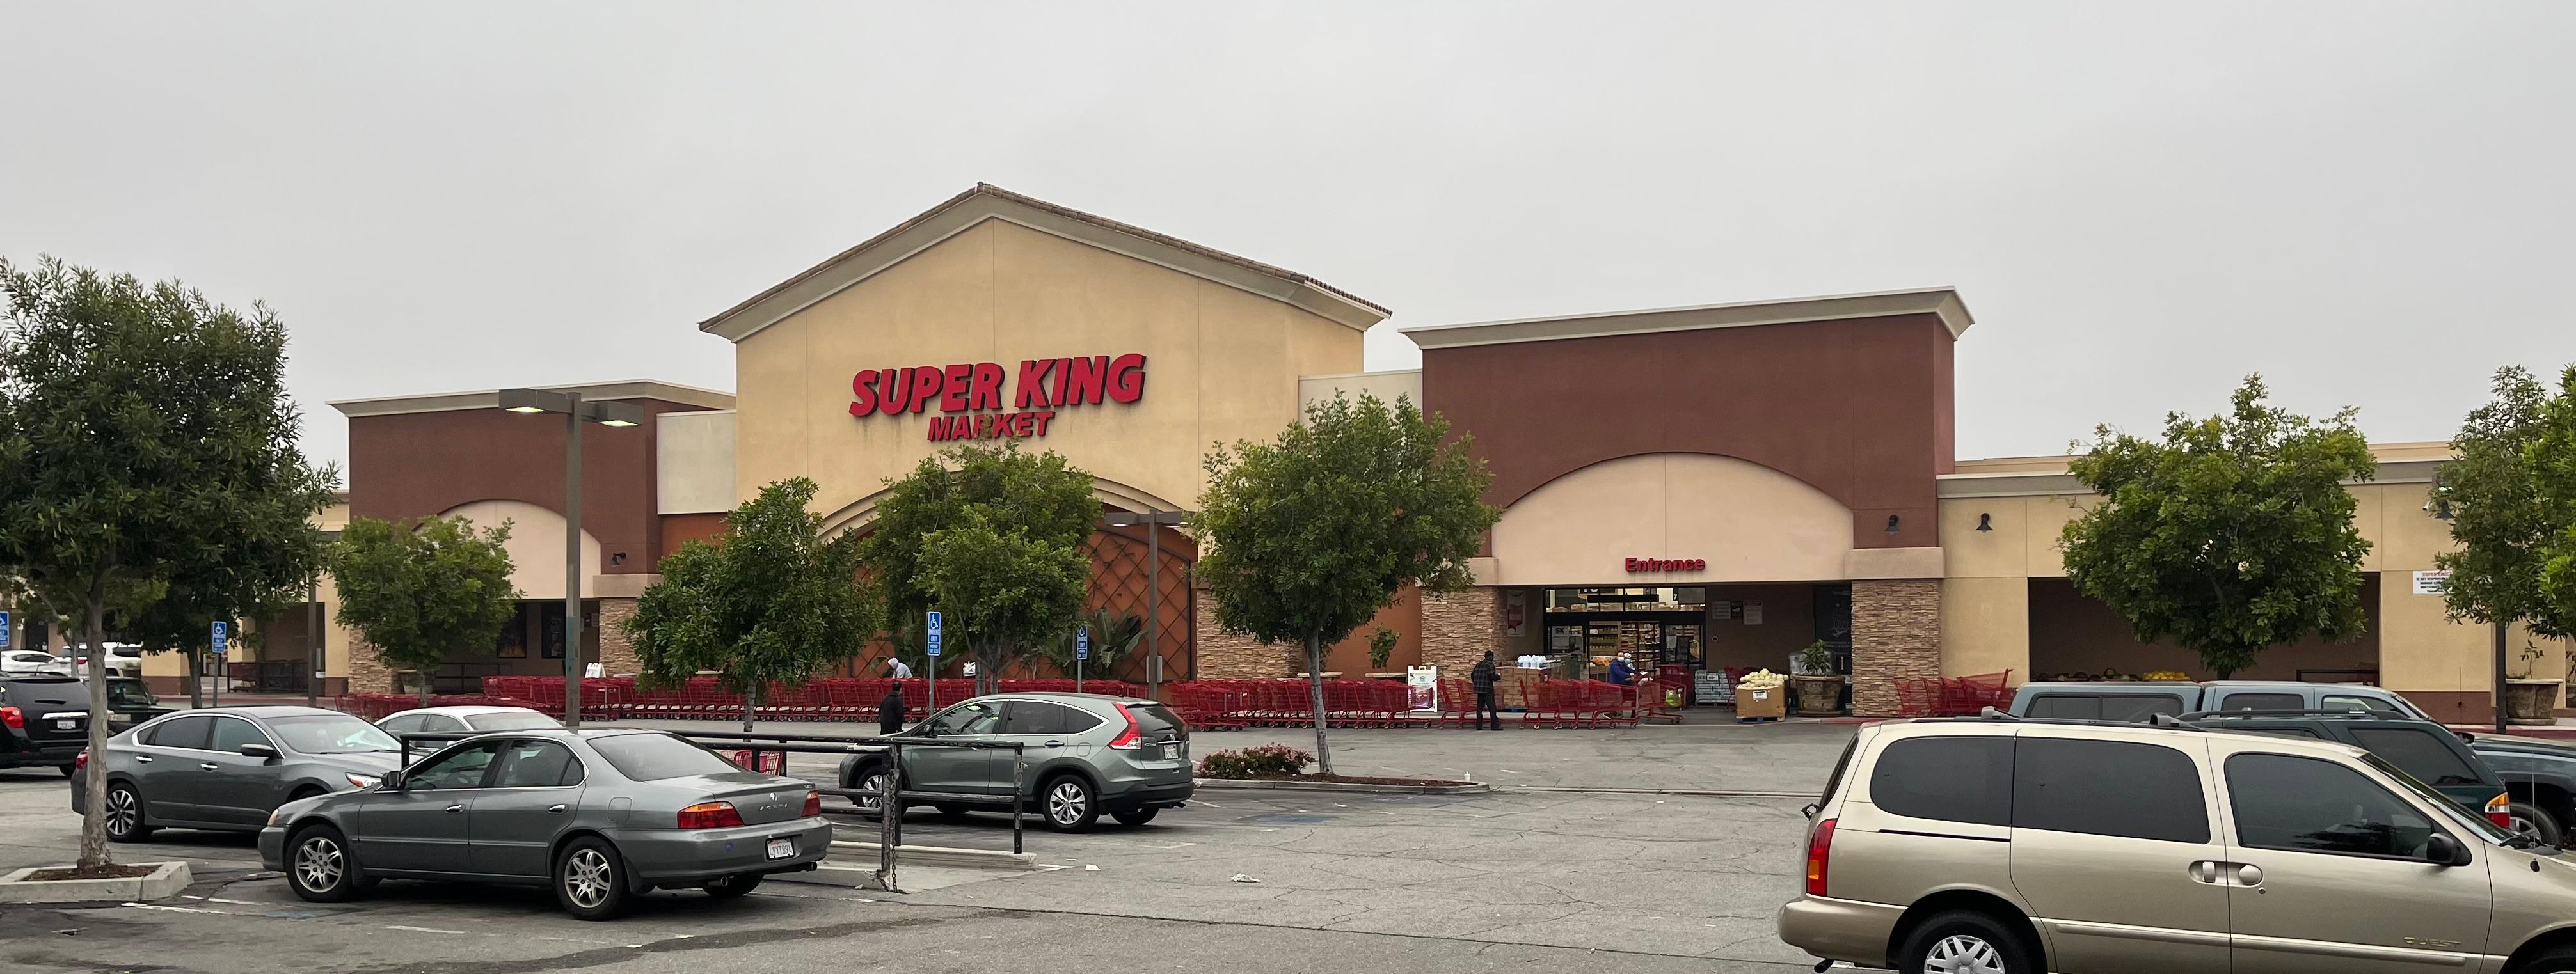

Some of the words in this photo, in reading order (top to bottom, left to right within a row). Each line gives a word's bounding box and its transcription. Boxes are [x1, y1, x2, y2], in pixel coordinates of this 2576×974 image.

[849, 362, 1005, 417] SUPER
[1015, 353, 1147, 408] KING
[927, 411, 1056, 441] MARKET
[1625, 558, 1705, 572] Entrance
[2404, 936, 2462, 948] QUEST
